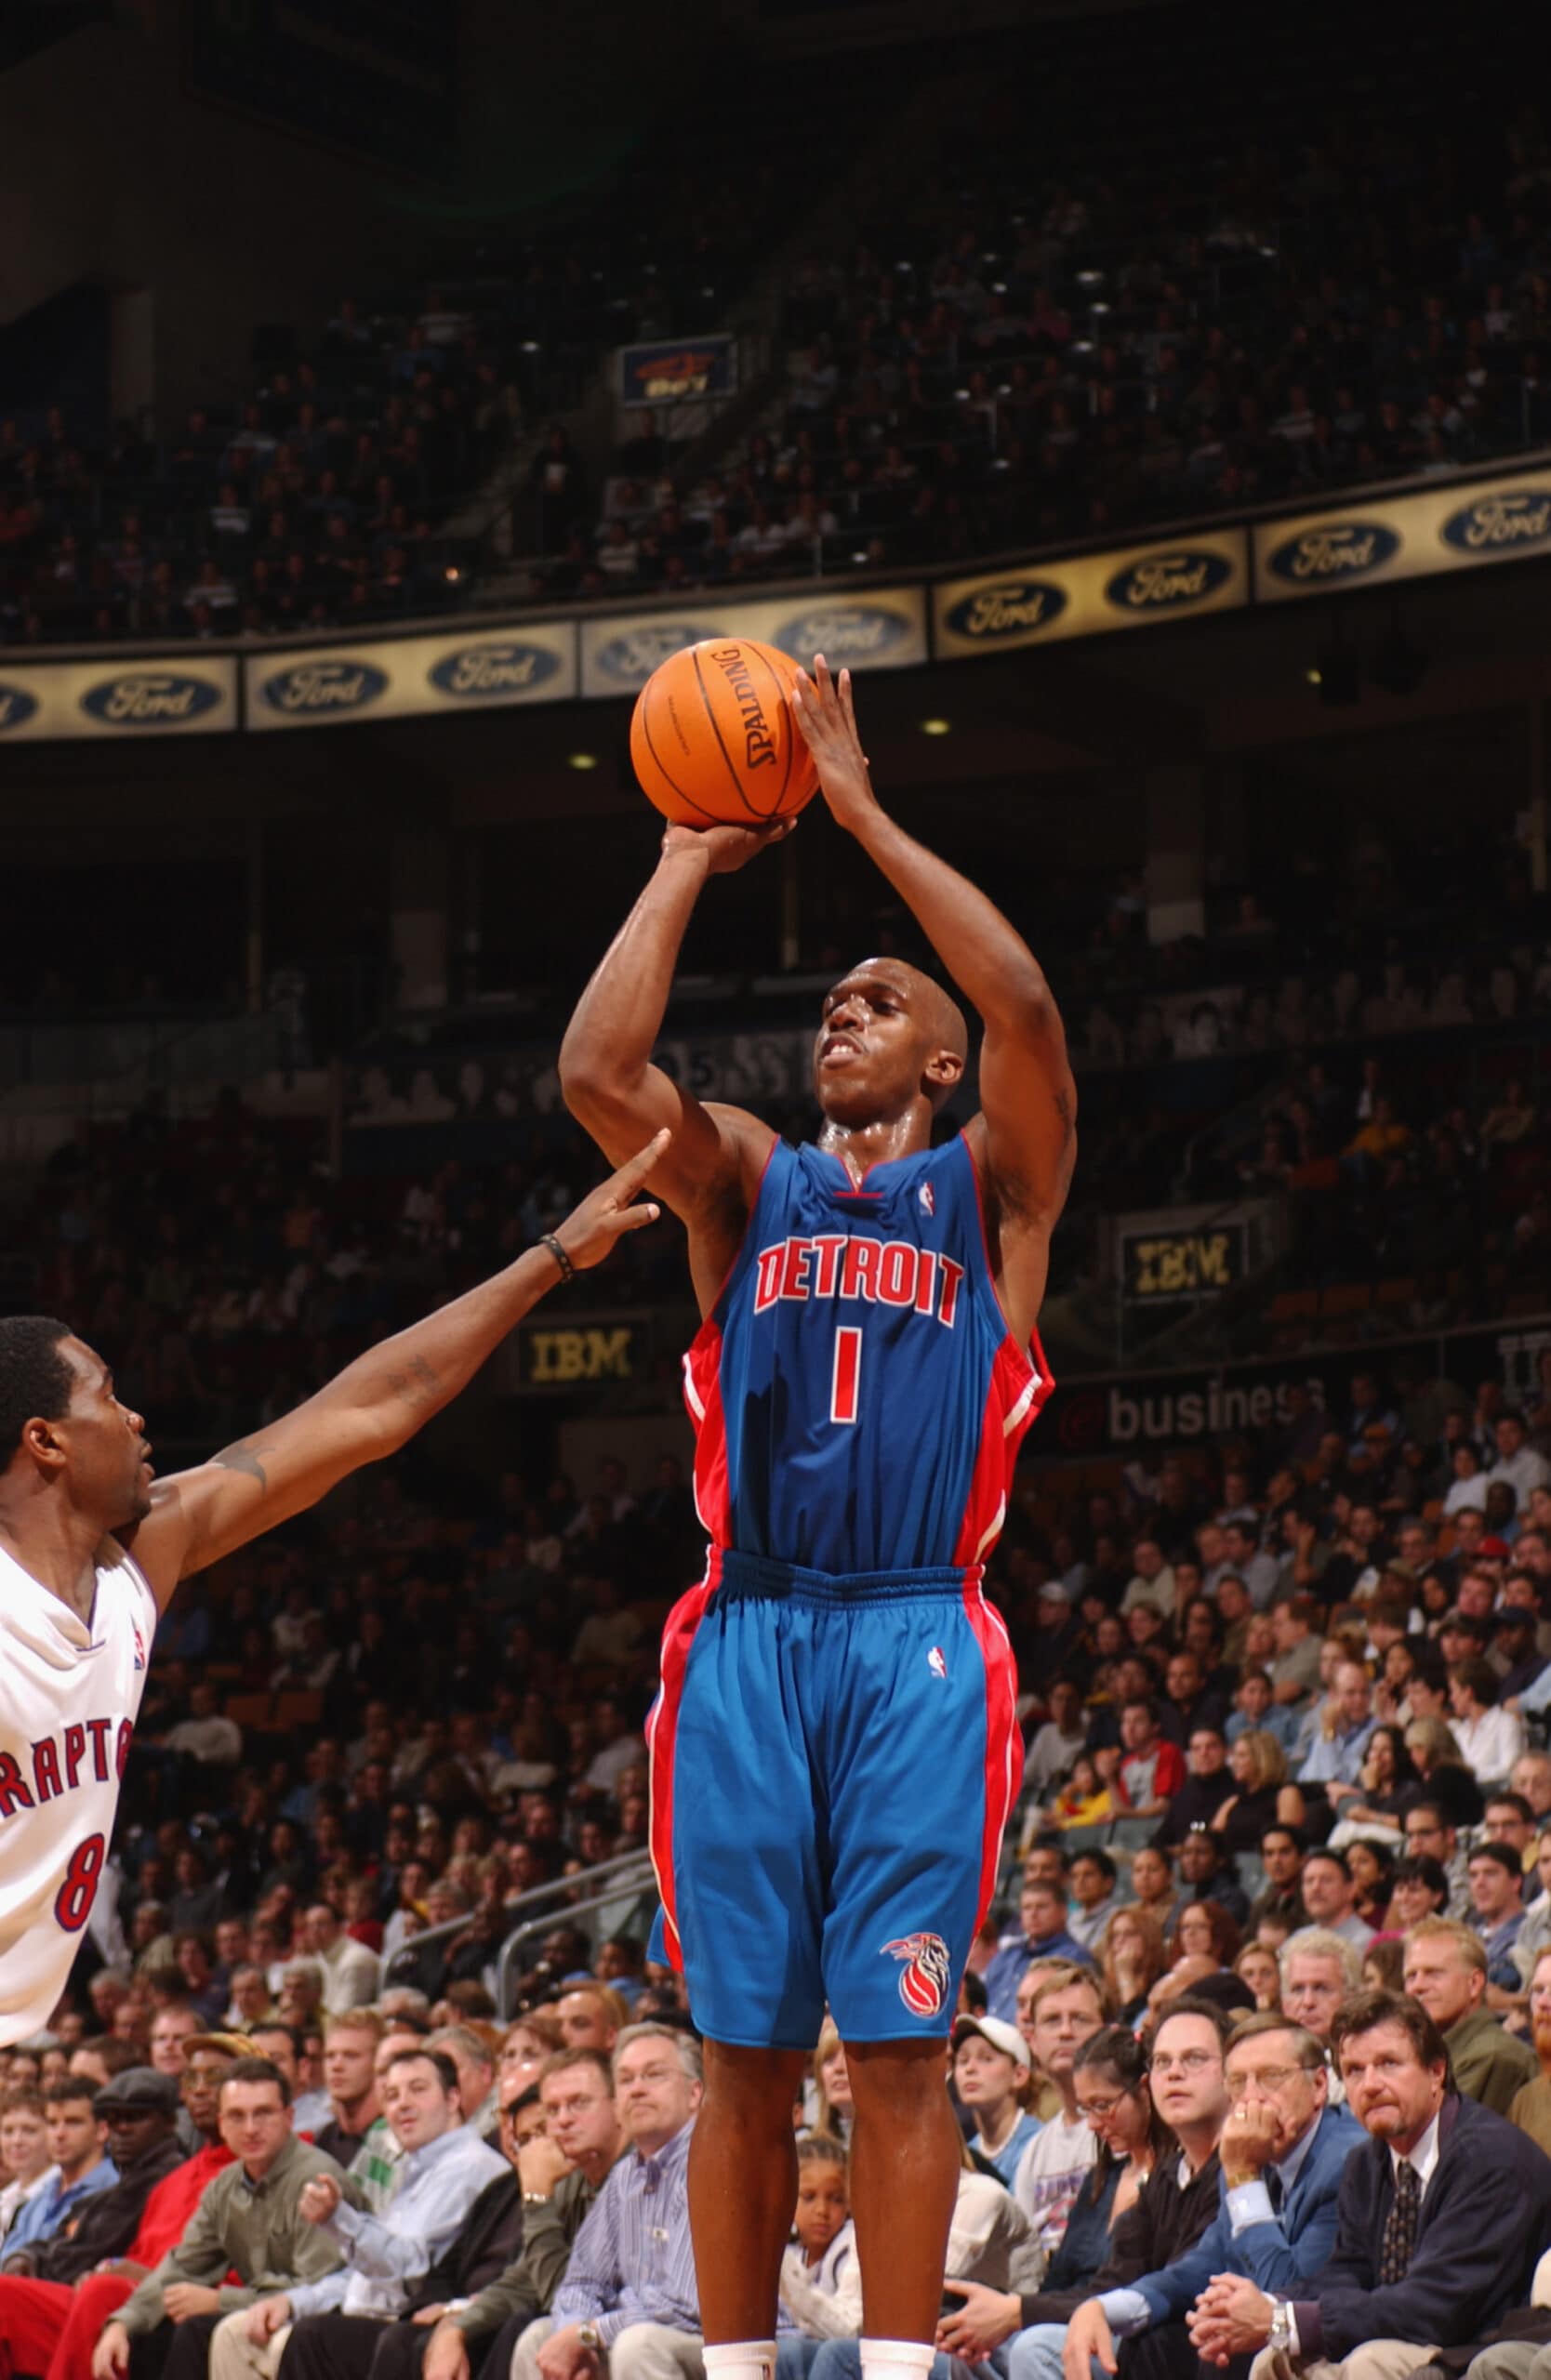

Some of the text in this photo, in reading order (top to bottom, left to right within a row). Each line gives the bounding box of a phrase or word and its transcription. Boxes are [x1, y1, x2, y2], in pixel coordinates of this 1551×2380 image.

[1465, 497, 1551, 546] Ford
[1292, 530, 1375, 576] Ford
[1128, 558, 1207, 604] Ford
[796, 614, 882, 654] Ford
[967, 588, 1044, 633] Ford
[283, 668, 365, 707] Ford
[450, 649, 537, 690] Ford
[104, 679, 195, 718] Ford
[711, 645, 777, 770] SPALDING
[754, 1235, 964, 1329] DETROIT
[1135, 1234, 1230, 1292] IBM
[530, 1328, 631, 1382] IBM
[830, 1327, 863, 1424] 1
[55, 1832, 105, 1933] 8
